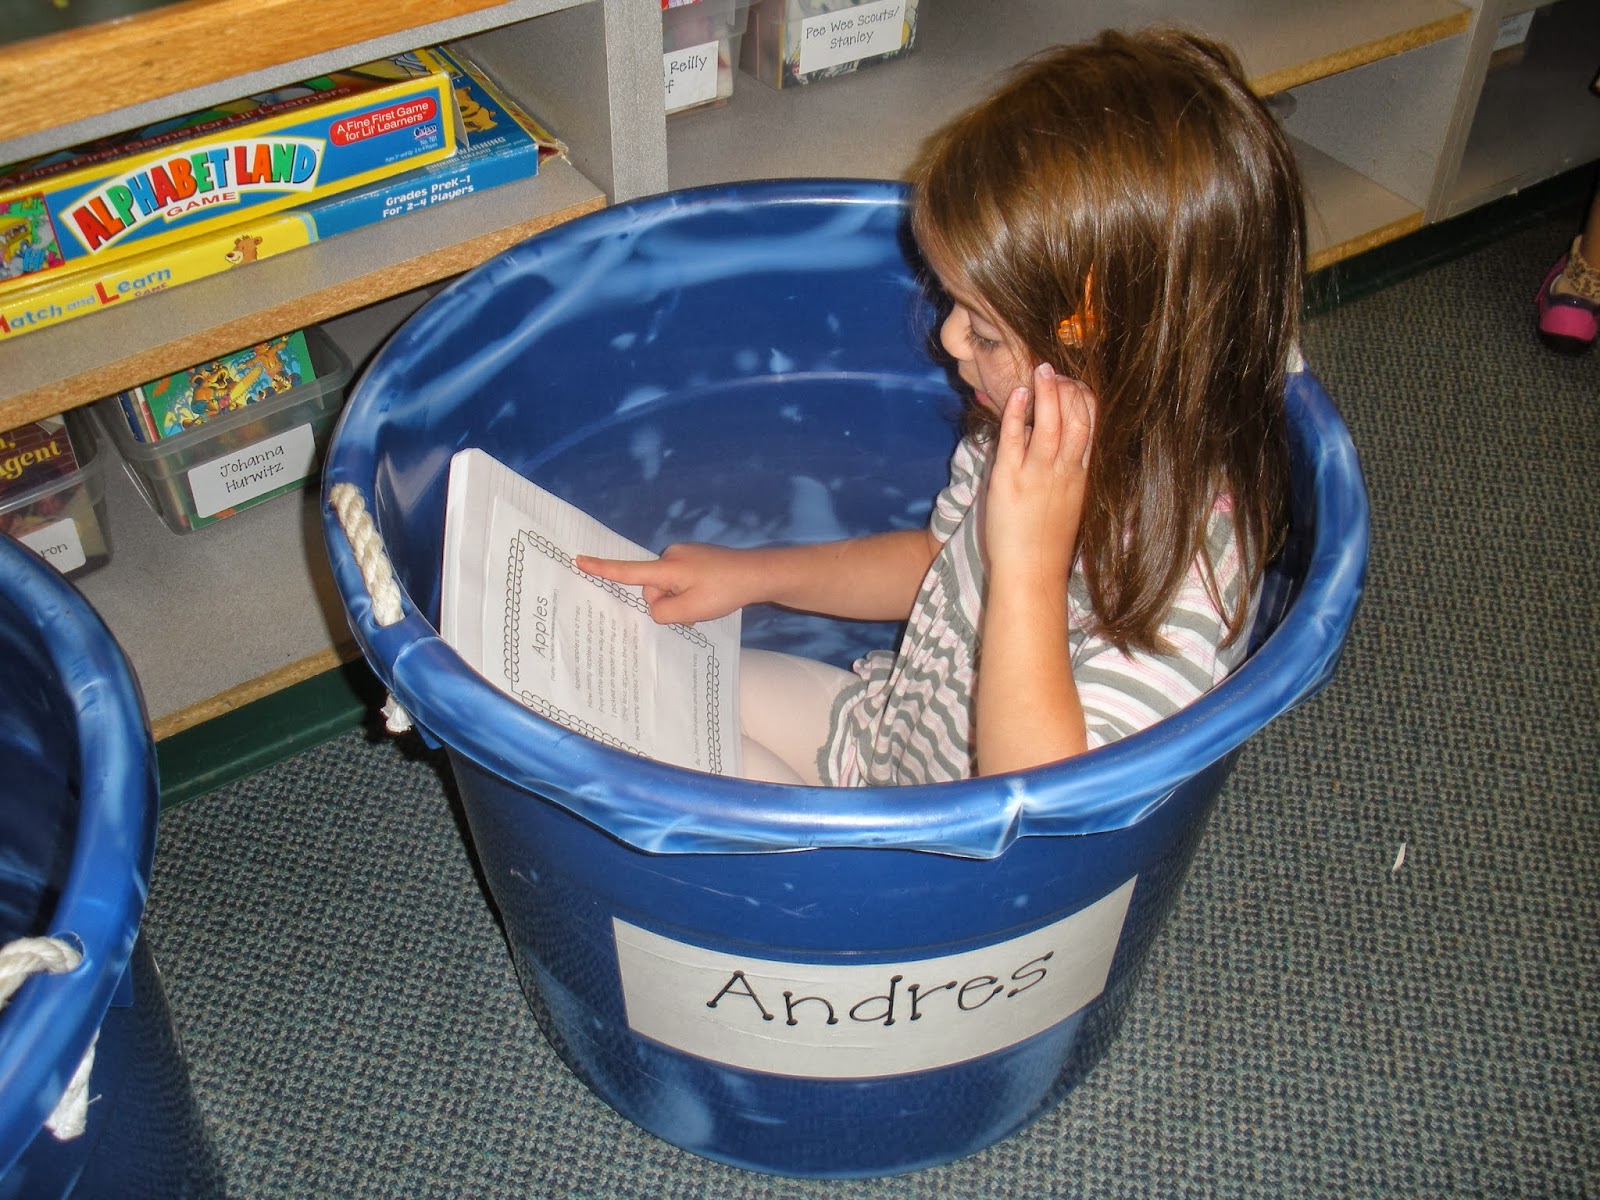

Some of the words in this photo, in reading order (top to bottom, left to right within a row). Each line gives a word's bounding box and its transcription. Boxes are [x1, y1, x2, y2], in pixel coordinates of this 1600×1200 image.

[806, 26, 827, 39] Pee
[831, 19, 854, 33] Wee
[830, 30, 874, 49] Stanley
[670, 55, 707, 74] Reilly
[337, 124, 346, 134] A
[346, 118, 370, 131] Fine
[371, 111, 396, 124] First
[396, 102, 429, 117] Game
[345, 131, 360, 141] for
[72, 148, 229, 250] ALPHABET
[234, 143, 317, 186] LAND
[166, 191, 237, 217] GAME
[382, 206, 403, 218] For
[430, 185, 475, 204] Players
[386, 188, 428, 206] Grades
[66, 294, 96, 311] and
[94, 268, 171, 305] Learn
[134, 282, 168, 297] GAME
[220, 445, 284, 477] Johanna
[225, 462, 284, 493] Hurwitz
[40, 543, 68, 559] ron
[531, 596, 550, 658] Apples
[707, 951, 1055, 1026] Andres
